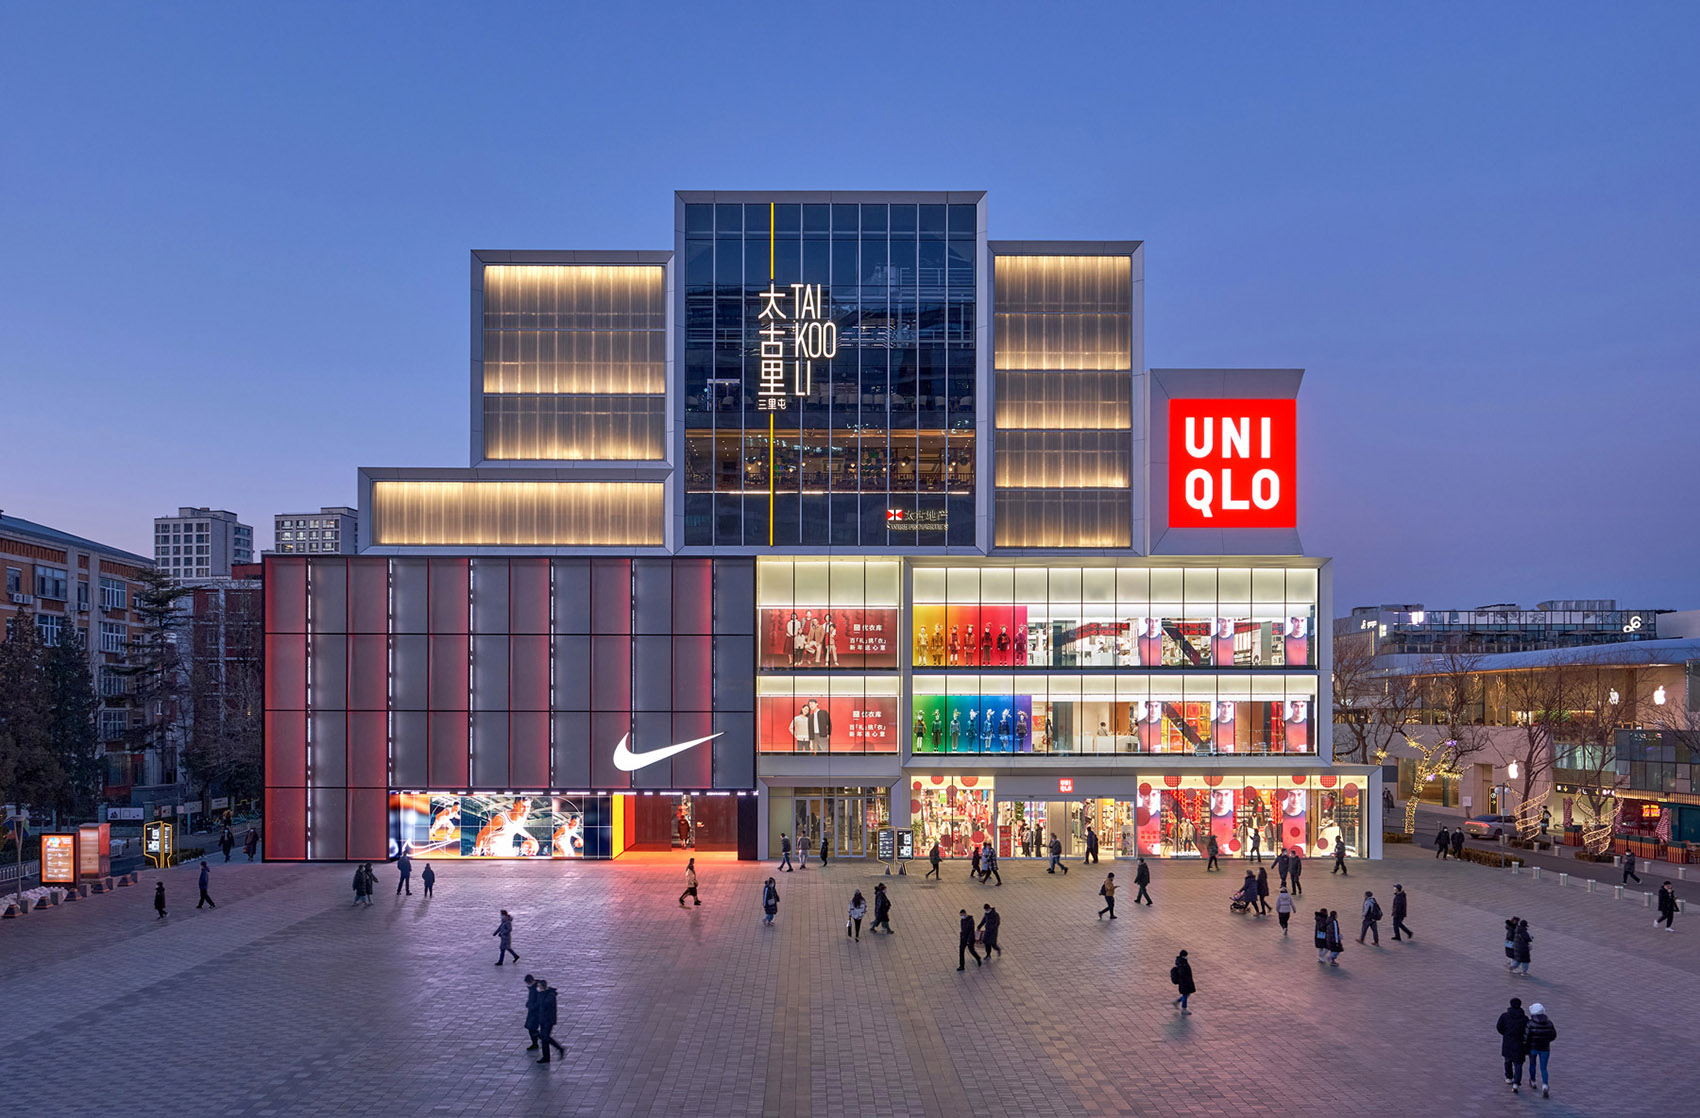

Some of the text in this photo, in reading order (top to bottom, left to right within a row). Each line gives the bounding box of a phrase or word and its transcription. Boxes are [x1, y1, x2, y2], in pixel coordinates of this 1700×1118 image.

[790, 283, 821, 319] TAI
[758, 283, 787, 396] 太古里
[795, 321, 837, 358] KOO
[795, 360, 811, 396] LI
[758, 398, 787, 410] 三里屯
[1185, 416, 1271, 459] UNI
[1185, 468, 1280, 518] QLO
